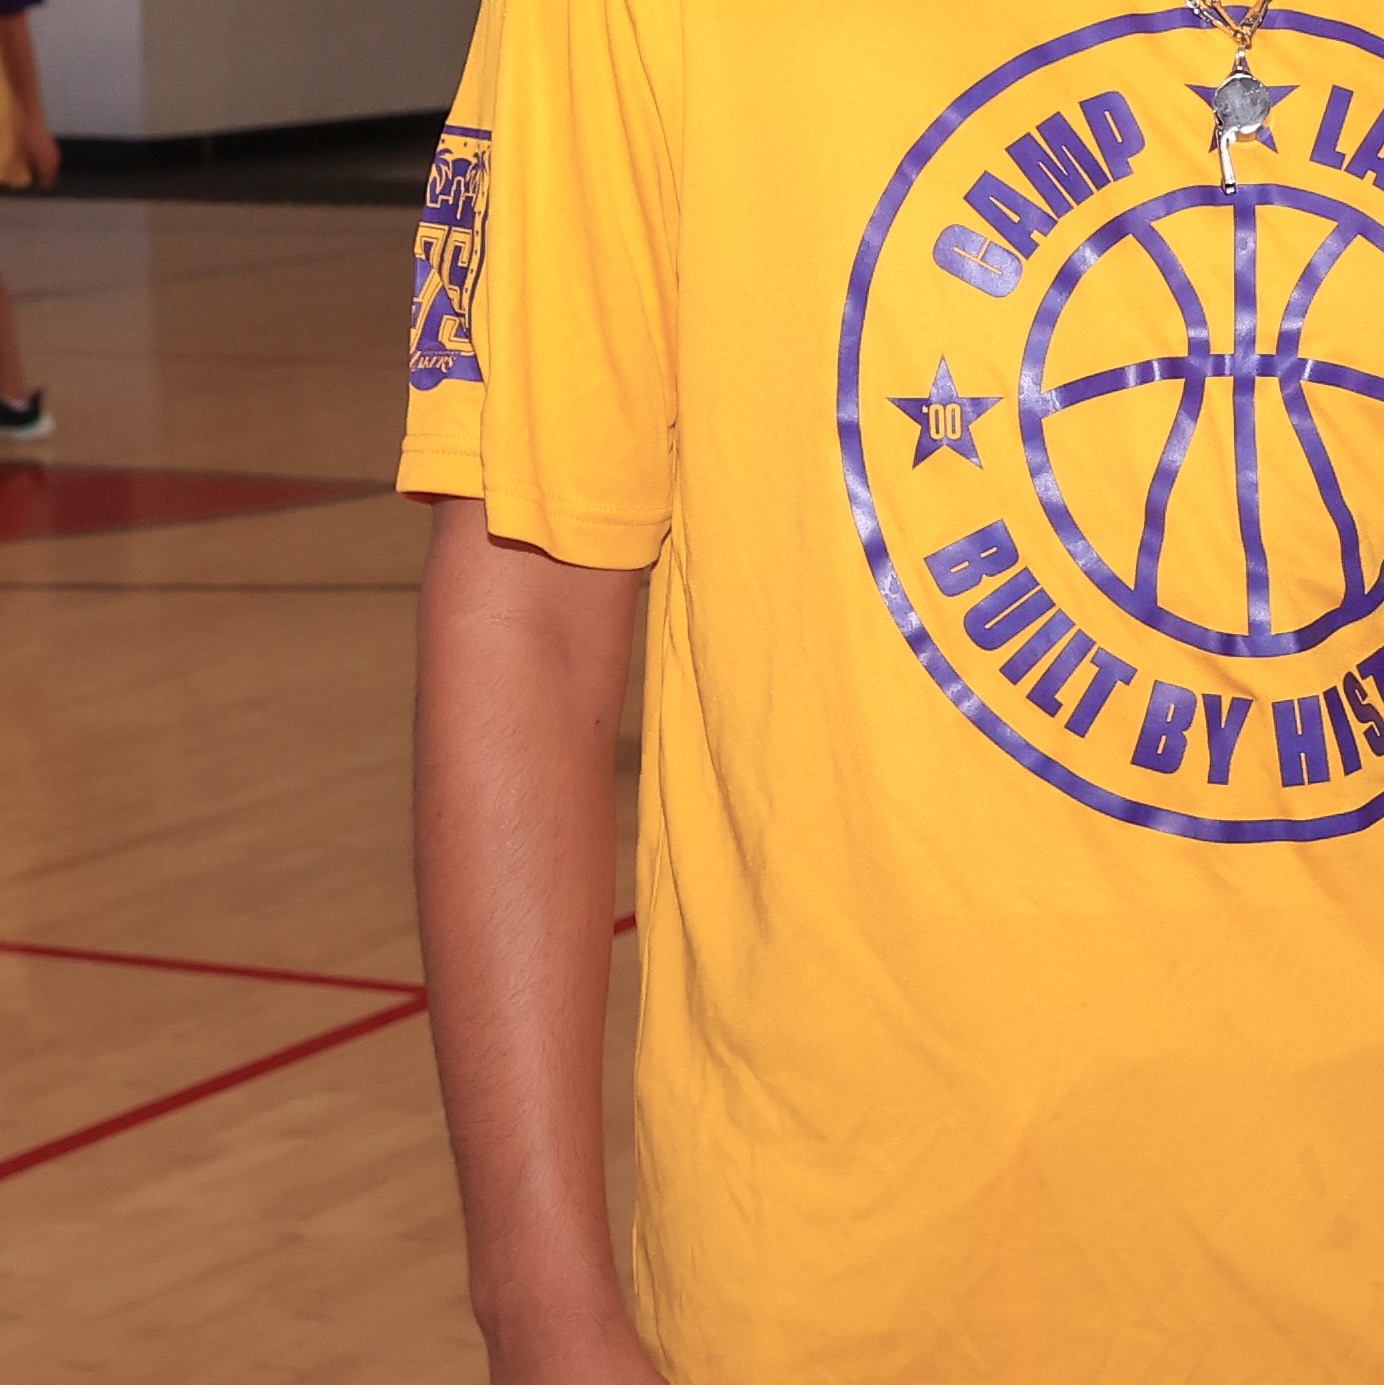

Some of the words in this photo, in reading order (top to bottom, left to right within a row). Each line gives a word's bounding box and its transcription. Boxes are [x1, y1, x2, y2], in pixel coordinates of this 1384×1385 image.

[932, 90, 1147, 299] CAMP
[923, 518, 1138, 737] BUILT
[1131, 680, 1251, 786] BY
